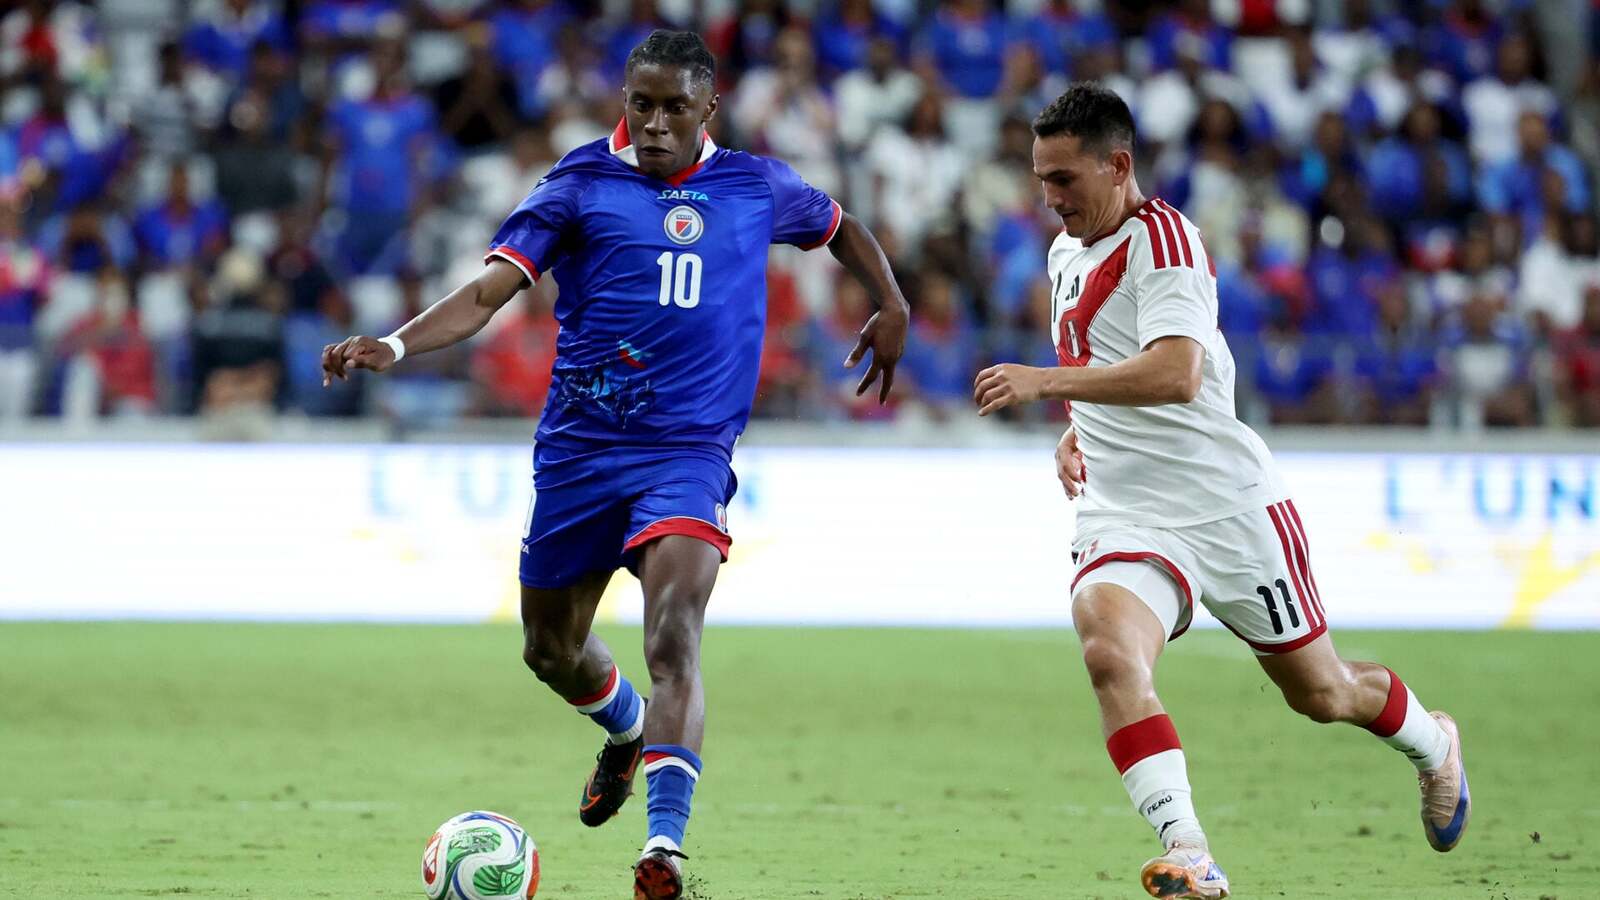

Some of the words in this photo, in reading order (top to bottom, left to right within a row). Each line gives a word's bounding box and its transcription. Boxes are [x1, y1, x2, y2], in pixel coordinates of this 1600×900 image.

[657, 190, 709, 201] SAETA
[656, 251, 702, 308] 10
[1256, 578, 1300, 635] 11
